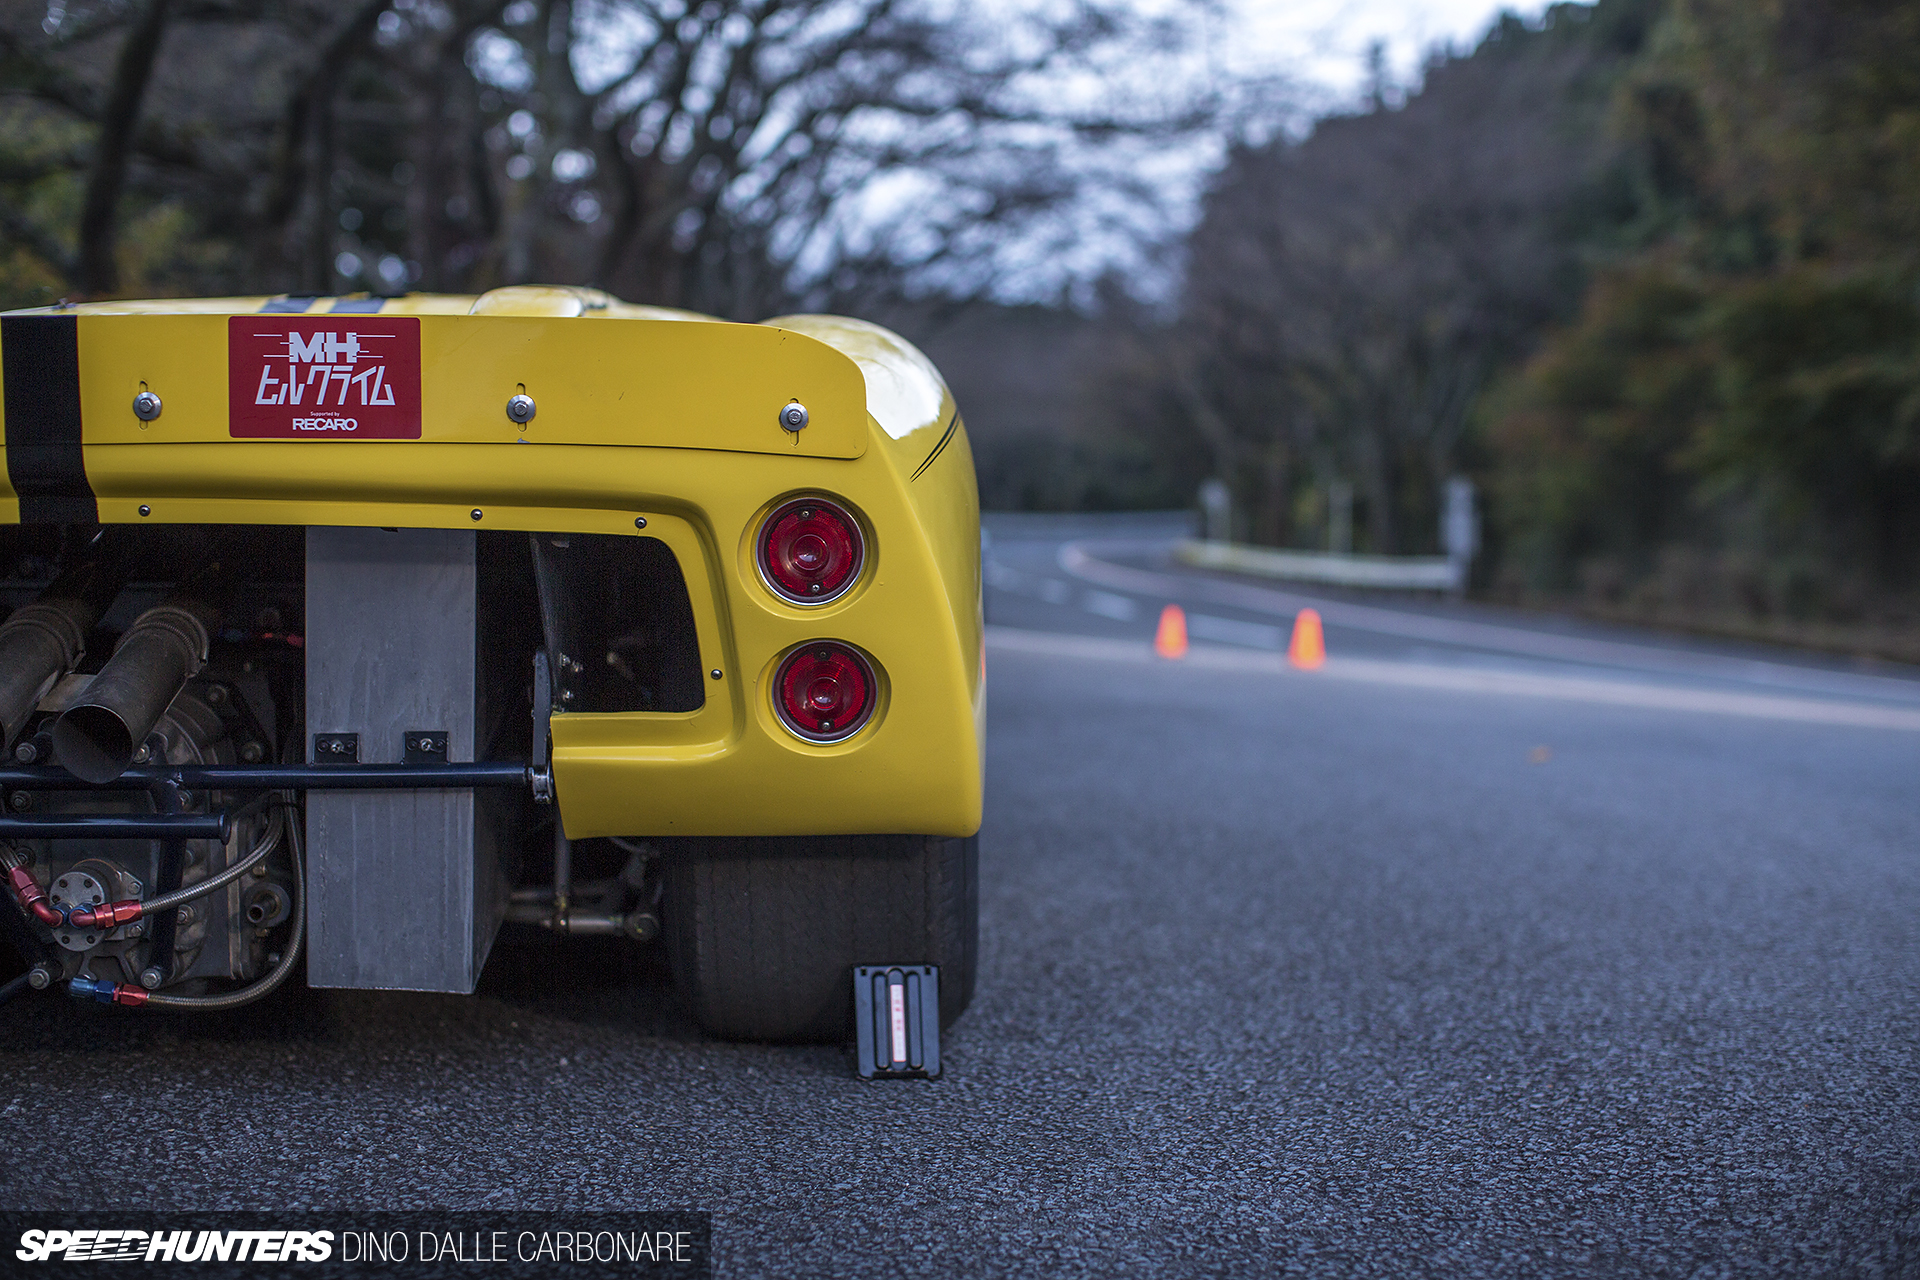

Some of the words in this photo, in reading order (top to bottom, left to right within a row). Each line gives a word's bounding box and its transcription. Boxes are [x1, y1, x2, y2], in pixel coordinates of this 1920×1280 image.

[288, 332, 361, 363] MH
[254, 365, 396, 406] ヒルクライム
[292, 418, 358, 431] RECARO
